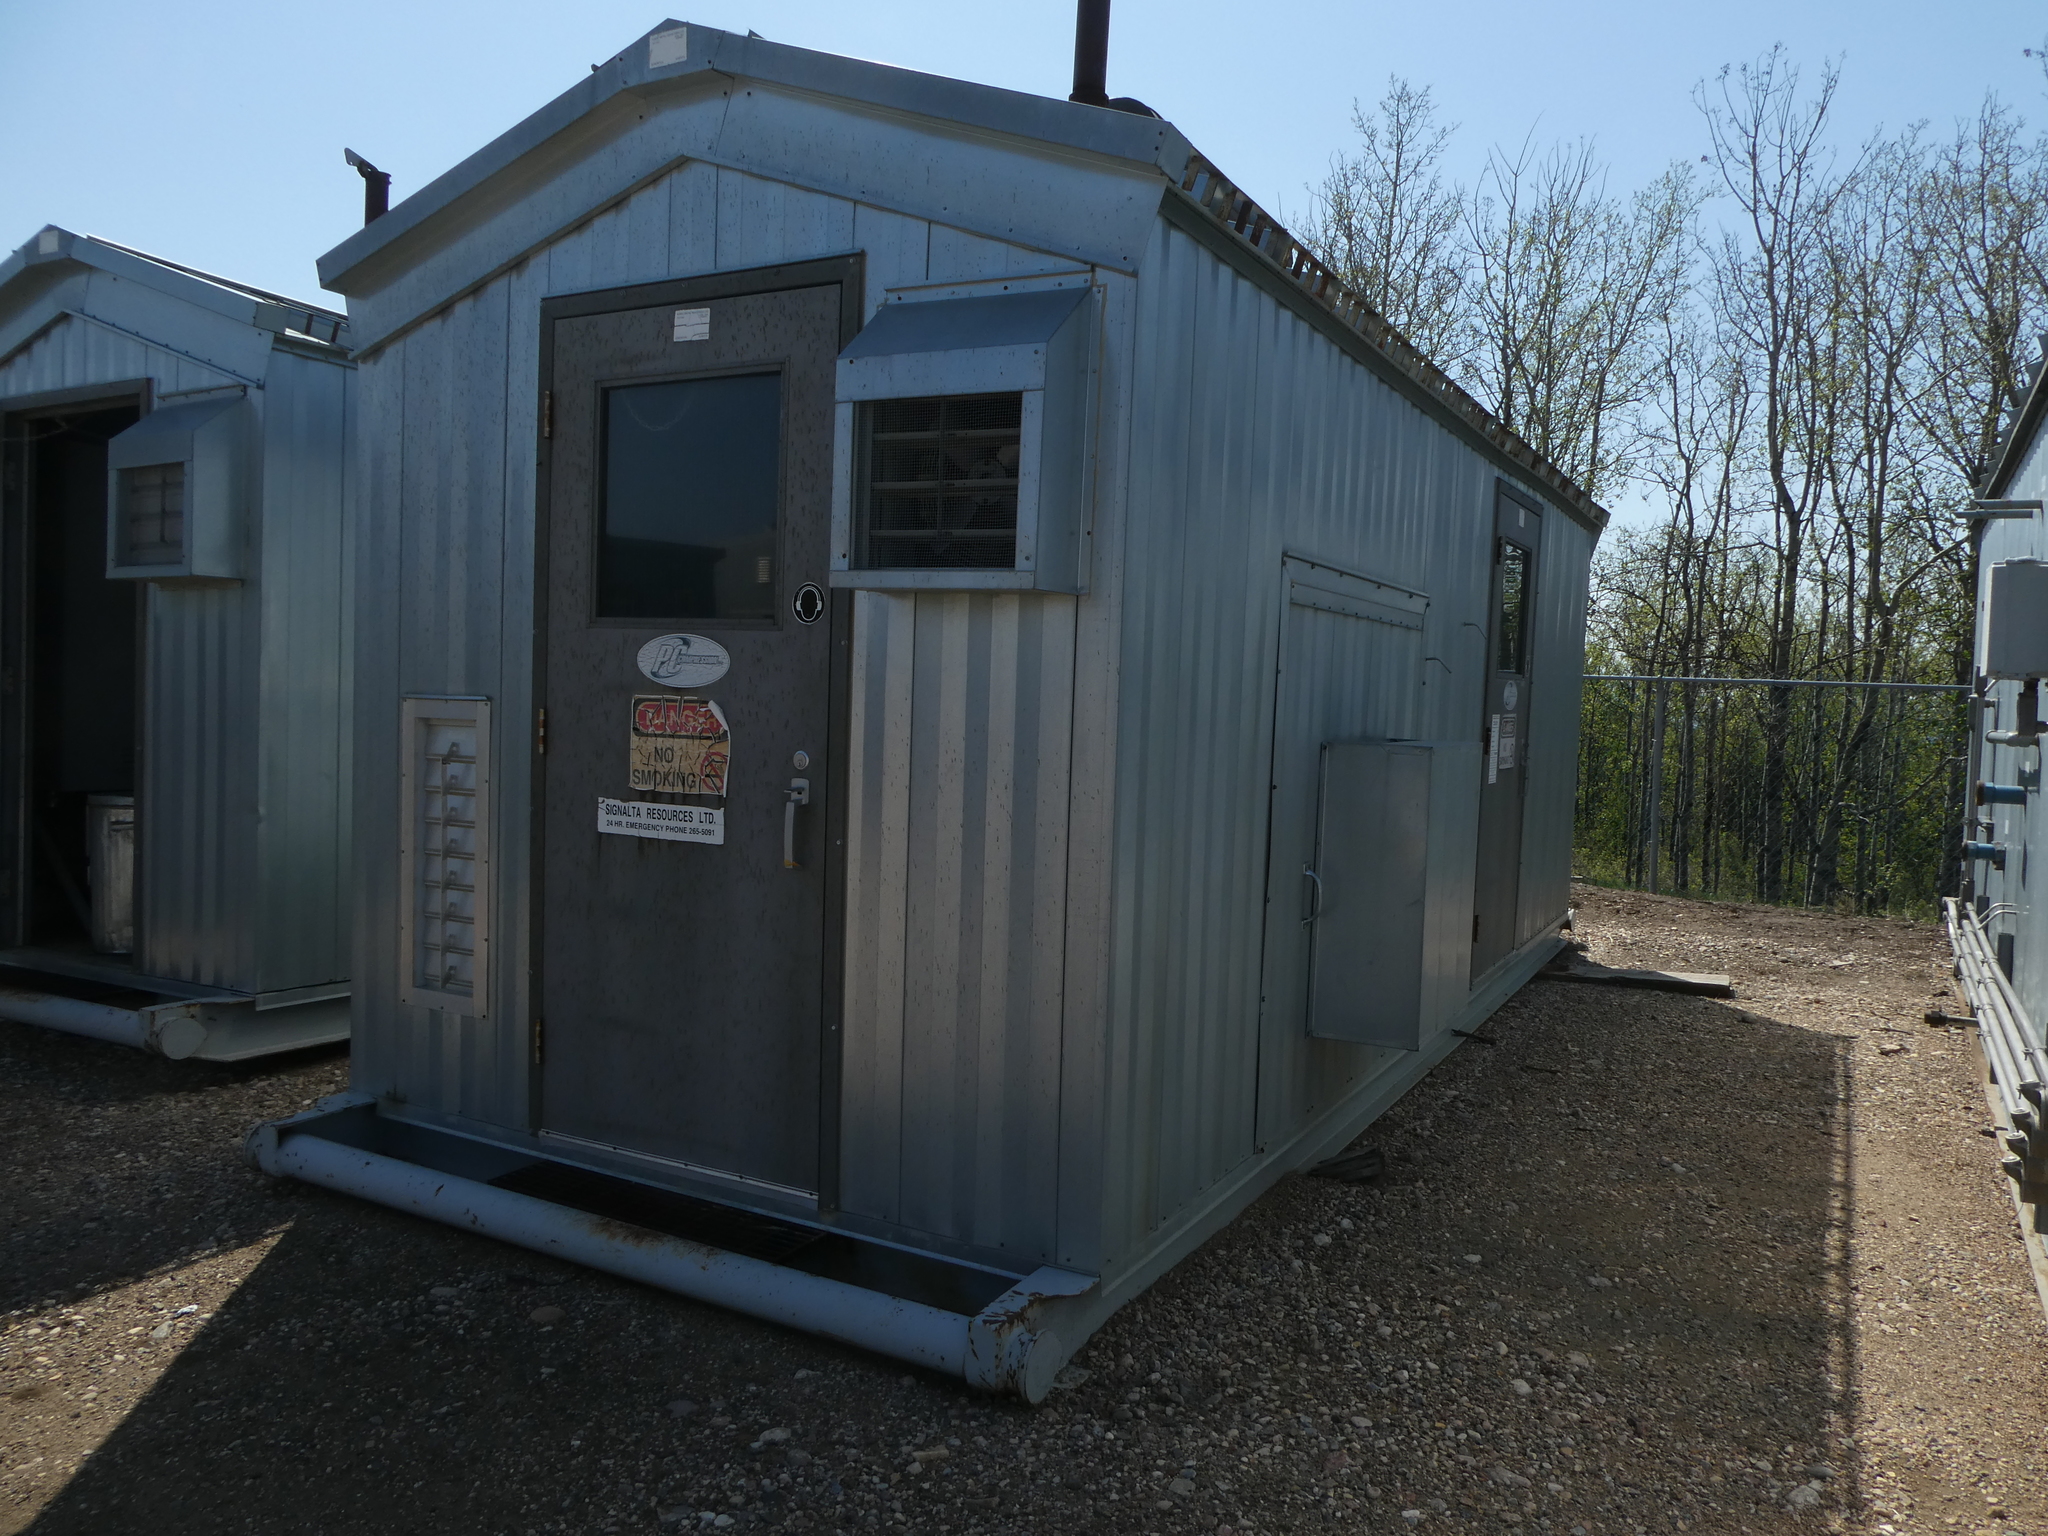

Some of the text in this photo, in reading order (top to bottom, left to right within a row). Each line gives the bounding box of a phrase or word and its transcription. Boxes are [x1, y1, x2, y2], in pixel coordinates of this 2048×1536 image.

[644, 707, 717, 729] DANGER
[654, 746, 674, 763] NO
[632, 769, 697, 789] SMOKING
[605, 803, 716, 824] SIGNALTA RESOURCES LTD.
[606, 819, 613, 827] 24
[626, 822, 664, 832] EMERGENCY
[665, 825, 688, 834] PHONE
[689, 827, 715, 836] 265-5091
